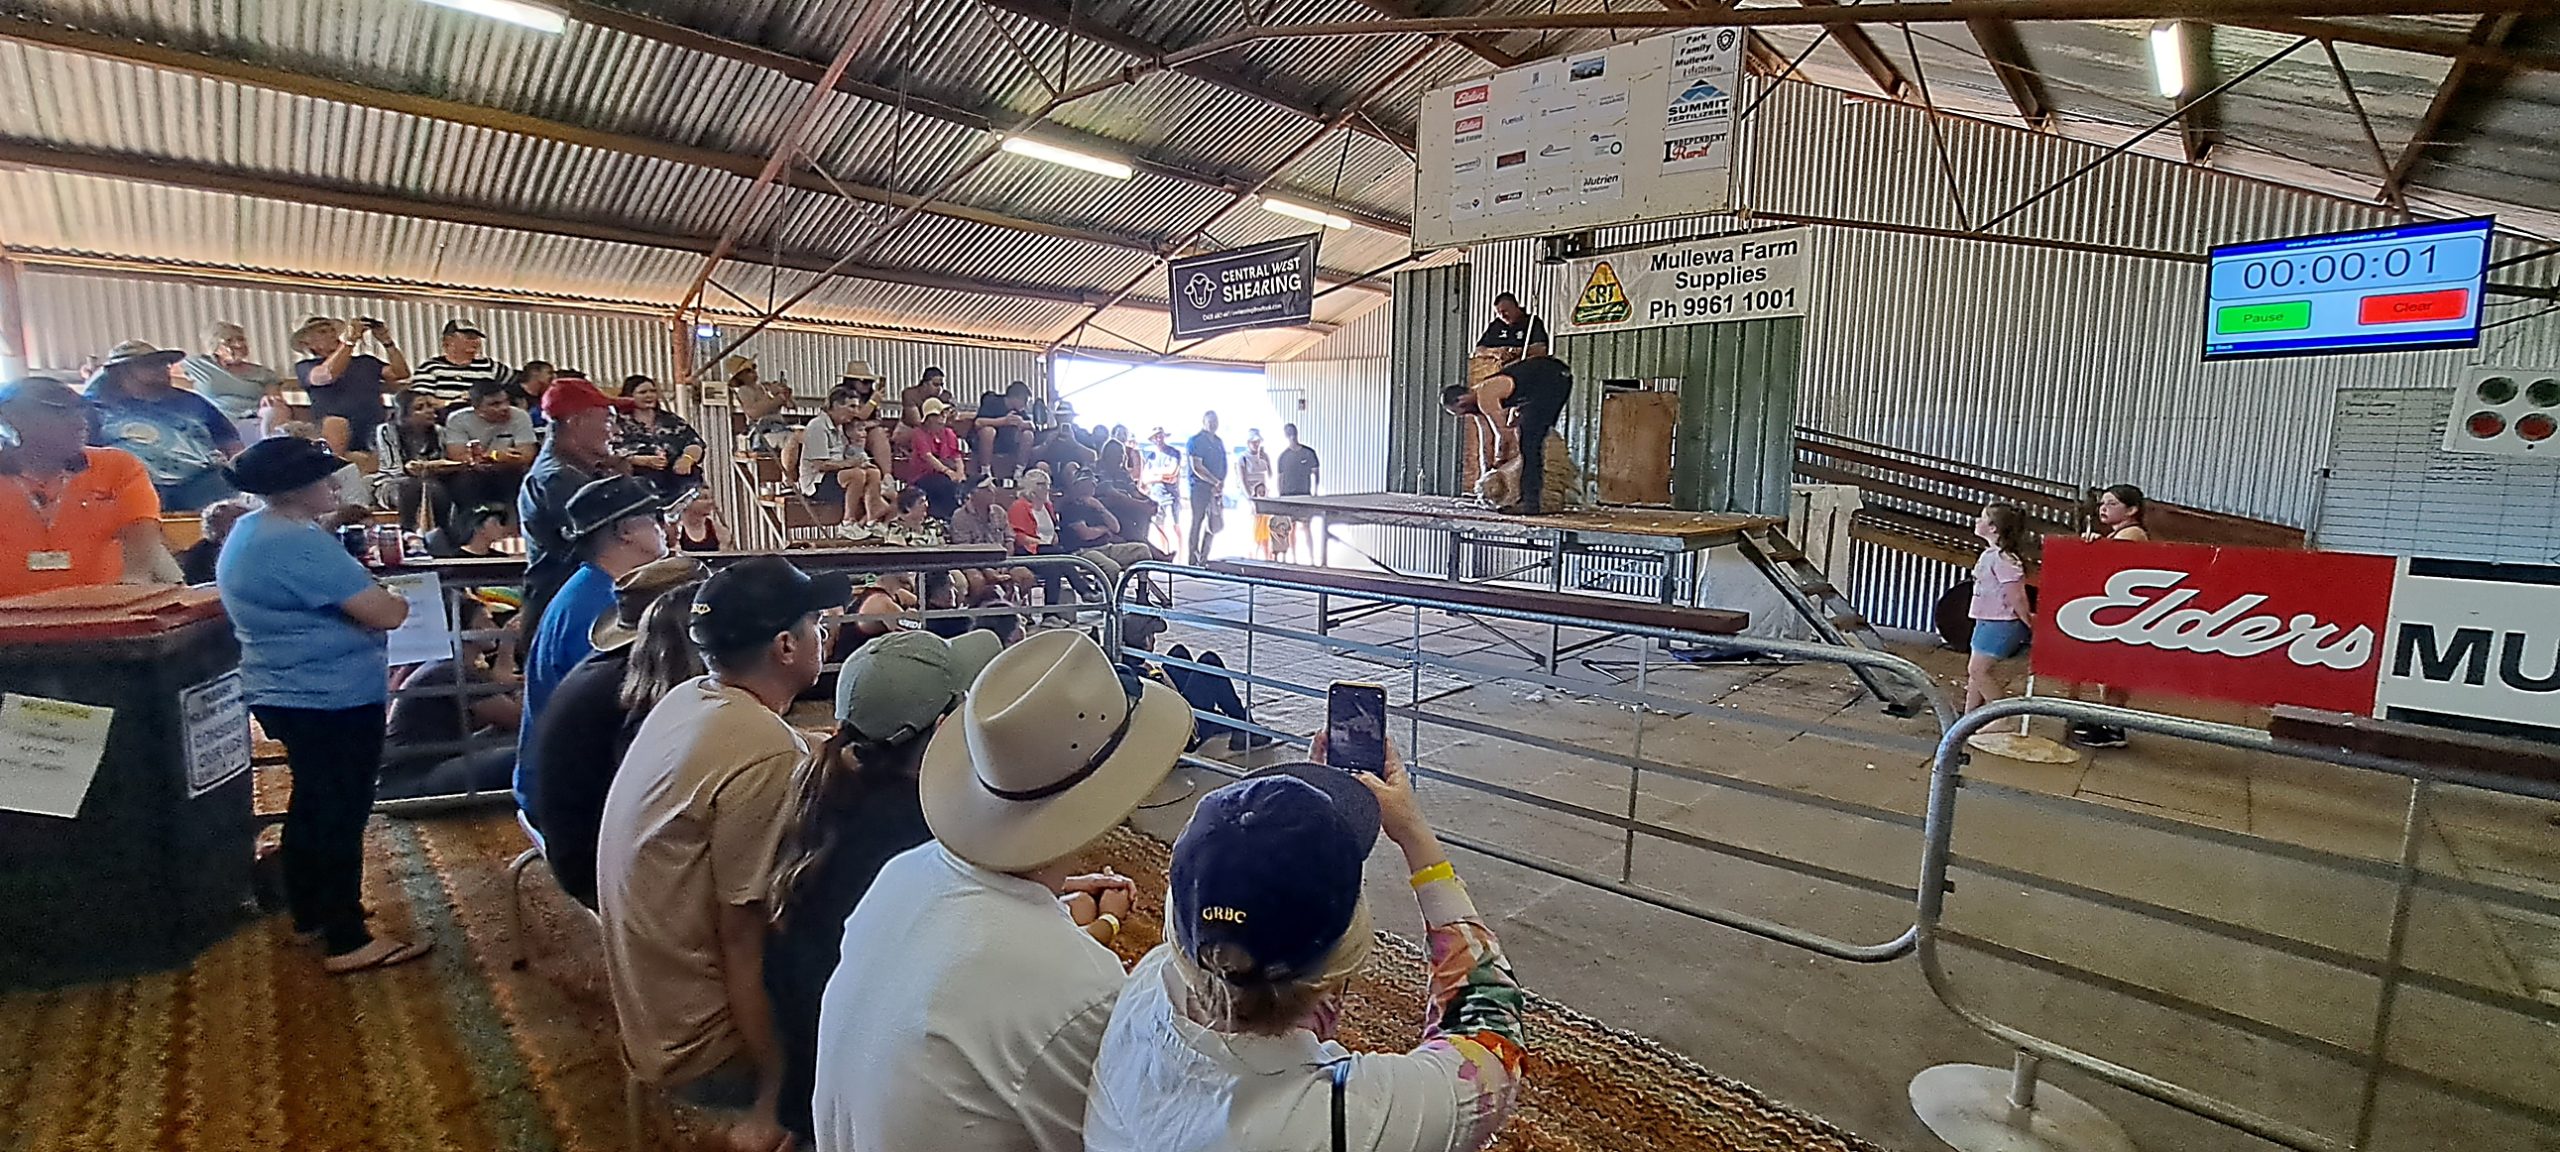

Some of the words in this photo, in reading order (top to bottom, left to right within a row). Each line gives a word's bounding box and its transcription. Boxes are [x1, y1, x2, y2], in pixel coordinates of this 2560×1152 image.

[1686, 33, 1707, 44] Park
[1680, 44, 1711, 56] Family
[1675, 54, 1714, 68] Mullewa
[1668, 98, 1730, 116] SUMMIT
[1668, 108, 1728, 123] FERTILIZERS
[1583, 174, 1619, 187] Nutrien
[1650, 250, 1734, 272] Mullewa
[1741, 239, 1798, 262] Farm
[1221, 264, 1270, 284] CENTRAL
[1271, 256, 1300, 275] WEST
[2243, 245, 2437, 289] 00:00:01
[1223, 273, 1301, 303] SHEARING
[1675, 266, 1767, 291] Supplies
[1585, 283, 1616, 304] CRT
[1650, 300, 1677, 320] Ph
[1683, 294, 1734, 317] 9961
[1742, 287, 1796, 311] 1001
[2243, 312, 2284, 323] Pause
[2393, 301, 2433, 313] Clear
[2056, 569, 2374, 670] Elders
[1203, 906, 1246, 923] GRBC
